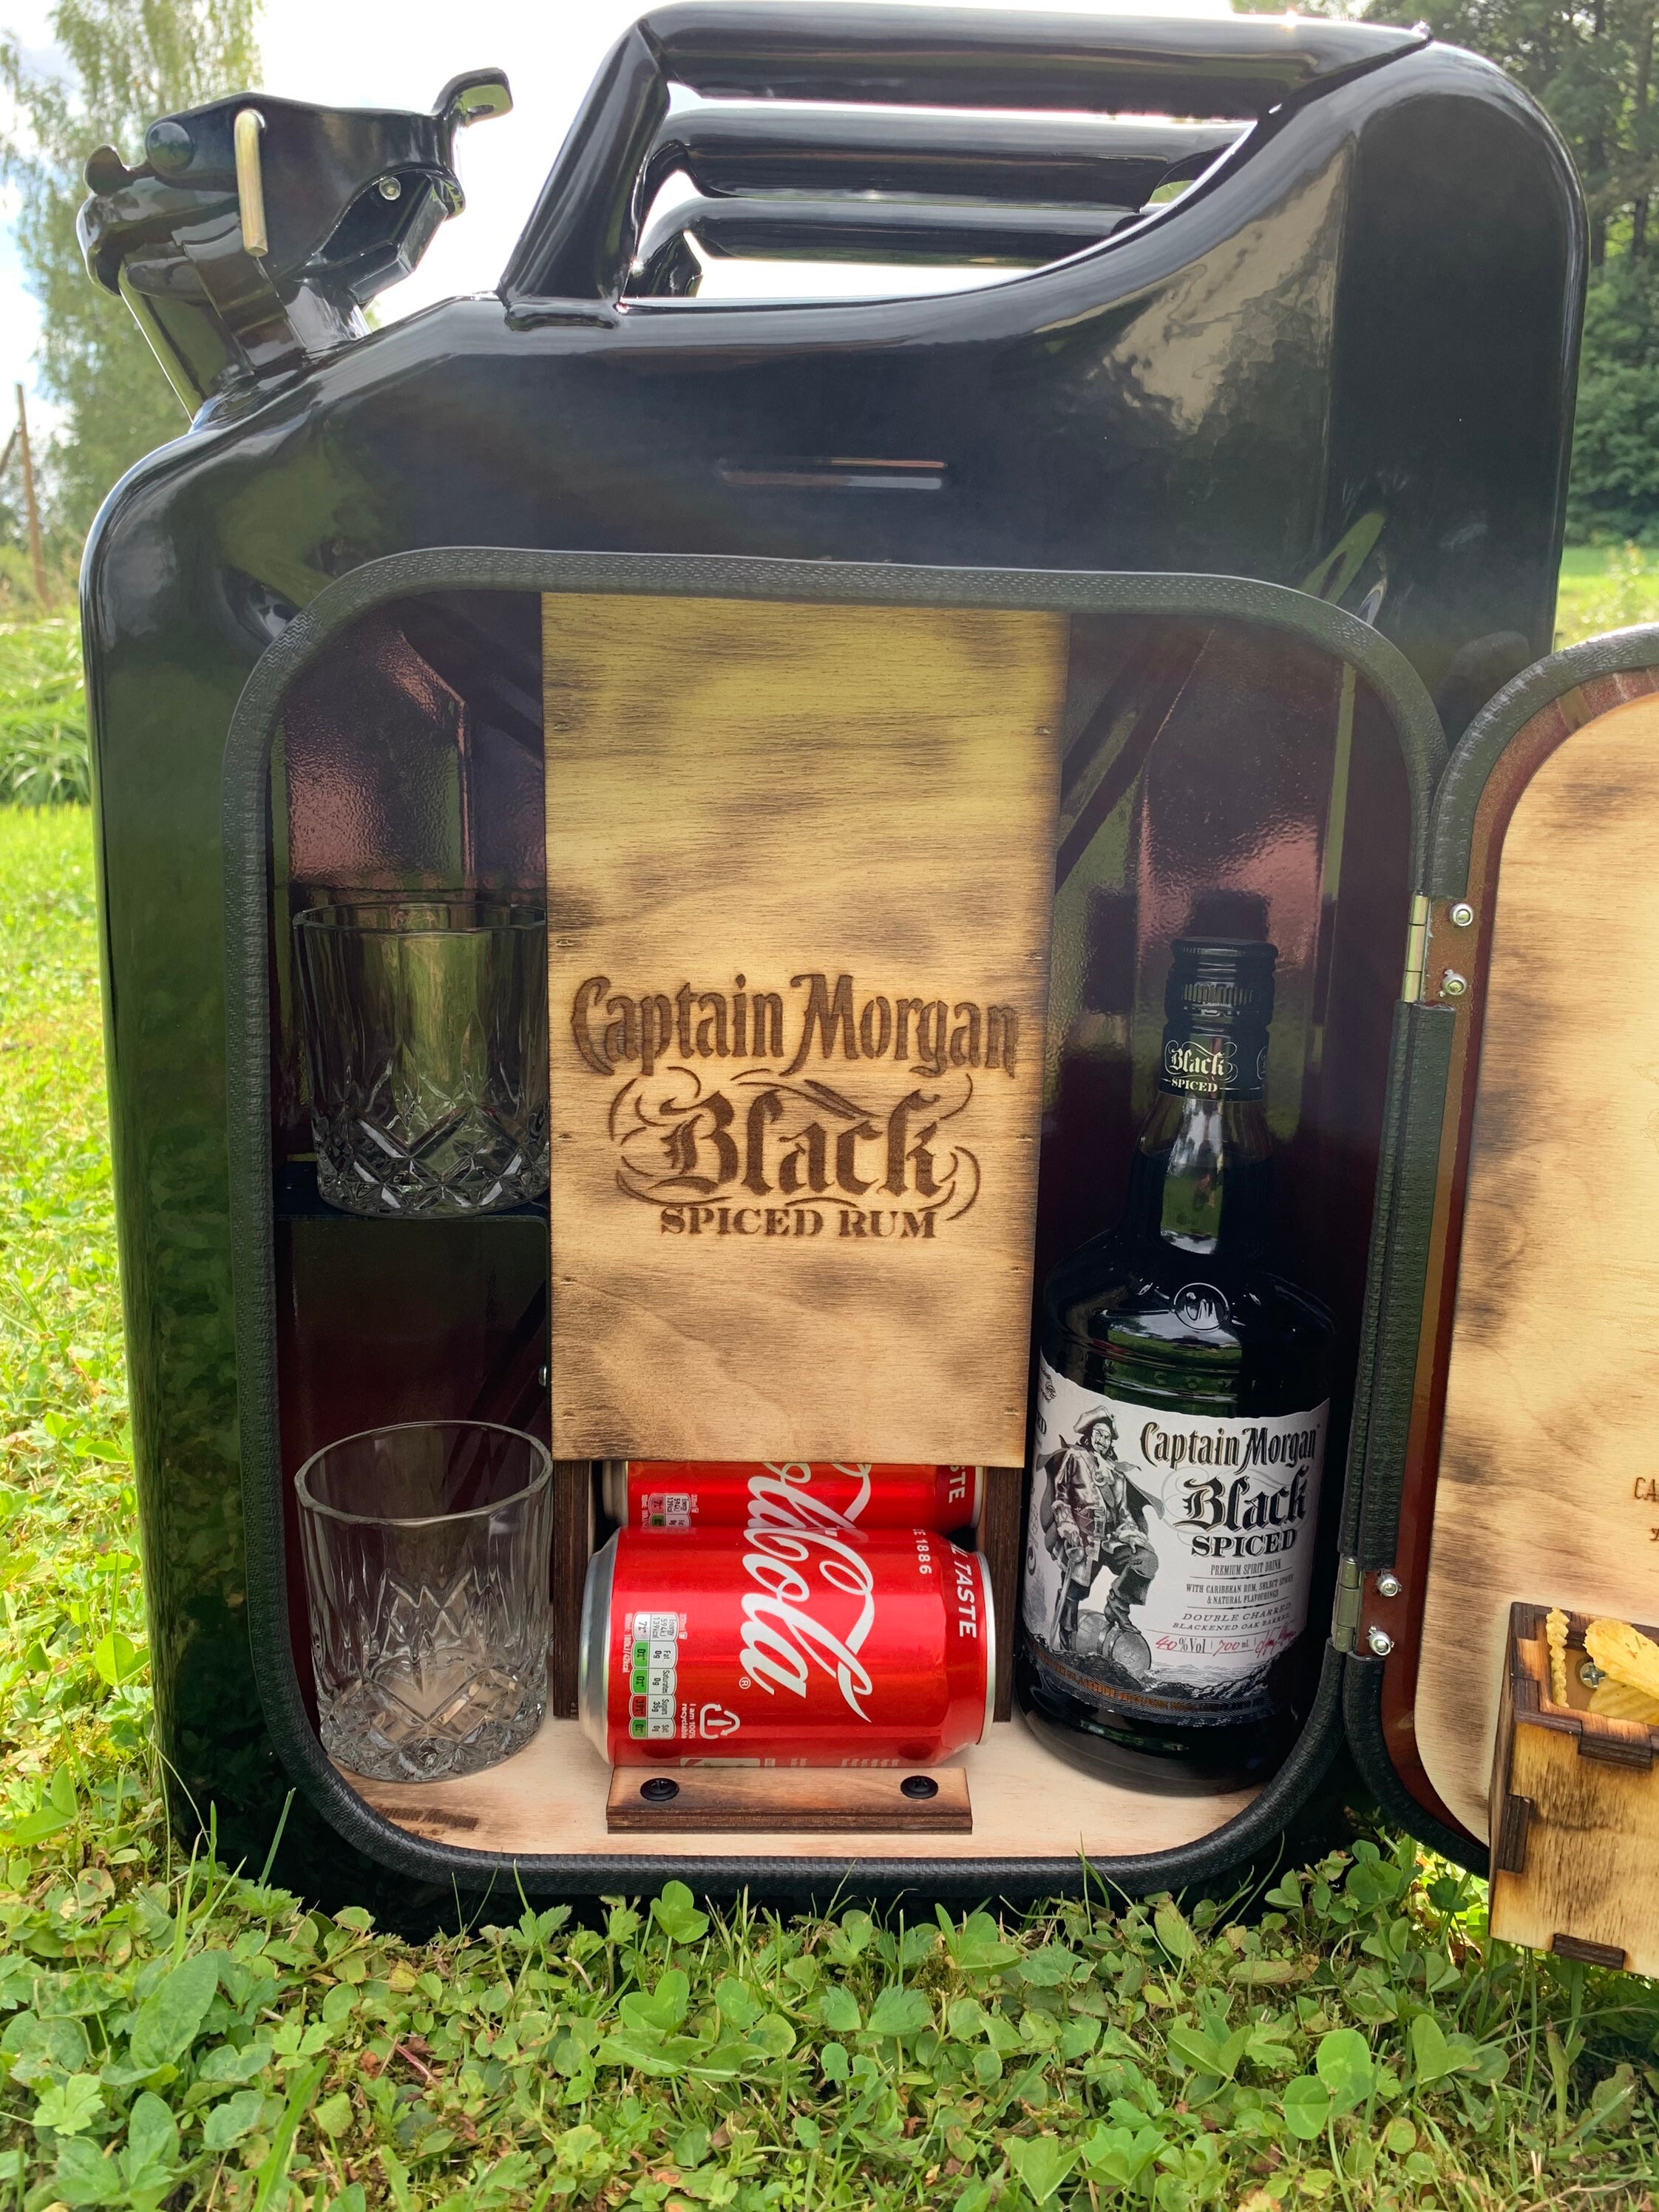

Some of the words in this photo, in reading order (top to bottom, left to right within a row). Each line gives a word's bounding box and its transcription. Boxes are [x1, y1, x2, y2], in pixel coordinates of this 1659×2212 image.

[571, 974, 784, 1076] Captain
[779, 974, 1019, 1078] Morgan
[1170, 1048, 1224, 1076] Black
[1171, 1077, 1218, 1092] SPICED
[655, 1088, 946, 1198] Black
[661, 1207, 823, 1236] SPICED
[838, 1210, 937, 1239] RUM
[1139, 1421, 1241, 1471] Captain
[1233, 1427, 1317, 1475] Morgan
[1173, 1465, 1309, 1533] Black
[1191, 1528, 1298, 1558] SPICED
[915, 1538, 932, 1575] 1886
[1210, 1564, 1242, 1575] PREMIUM
[1243, 1562, 1264, 1575] SPIRIT
[1265, 1558, 1281, 1572] DRINK
[954, 1560, 977, 1638] TASTE
[1186, 1584, 1204, 1593] WITH
[1206, 1584, 1242, 1594] CARIBBEAN
[1207, 1596, 1211, 1604] &
[1212, 1595, 1242, 1604] NATURAL
[1172, 1622, 1238, 1631] BLACKENED
[1241, 1621, 1259, 1630] OAK
[1261, 1613, 1291, 1626] BARREL
[1181, 1612, 1239, 1622] DOUBLE
[1242, 1602, 1292, 1621] CHARRED
[654, 1650, 662, 1659] 0g
[1212, 1638, 1240, 1657] 700
[653, 1677, 661, 1686] 0g
[651, 1701, 660, 1713] 35g
[689, 1707, 696, 1720] am
[680, 1703, 688, 1739] recyclable
